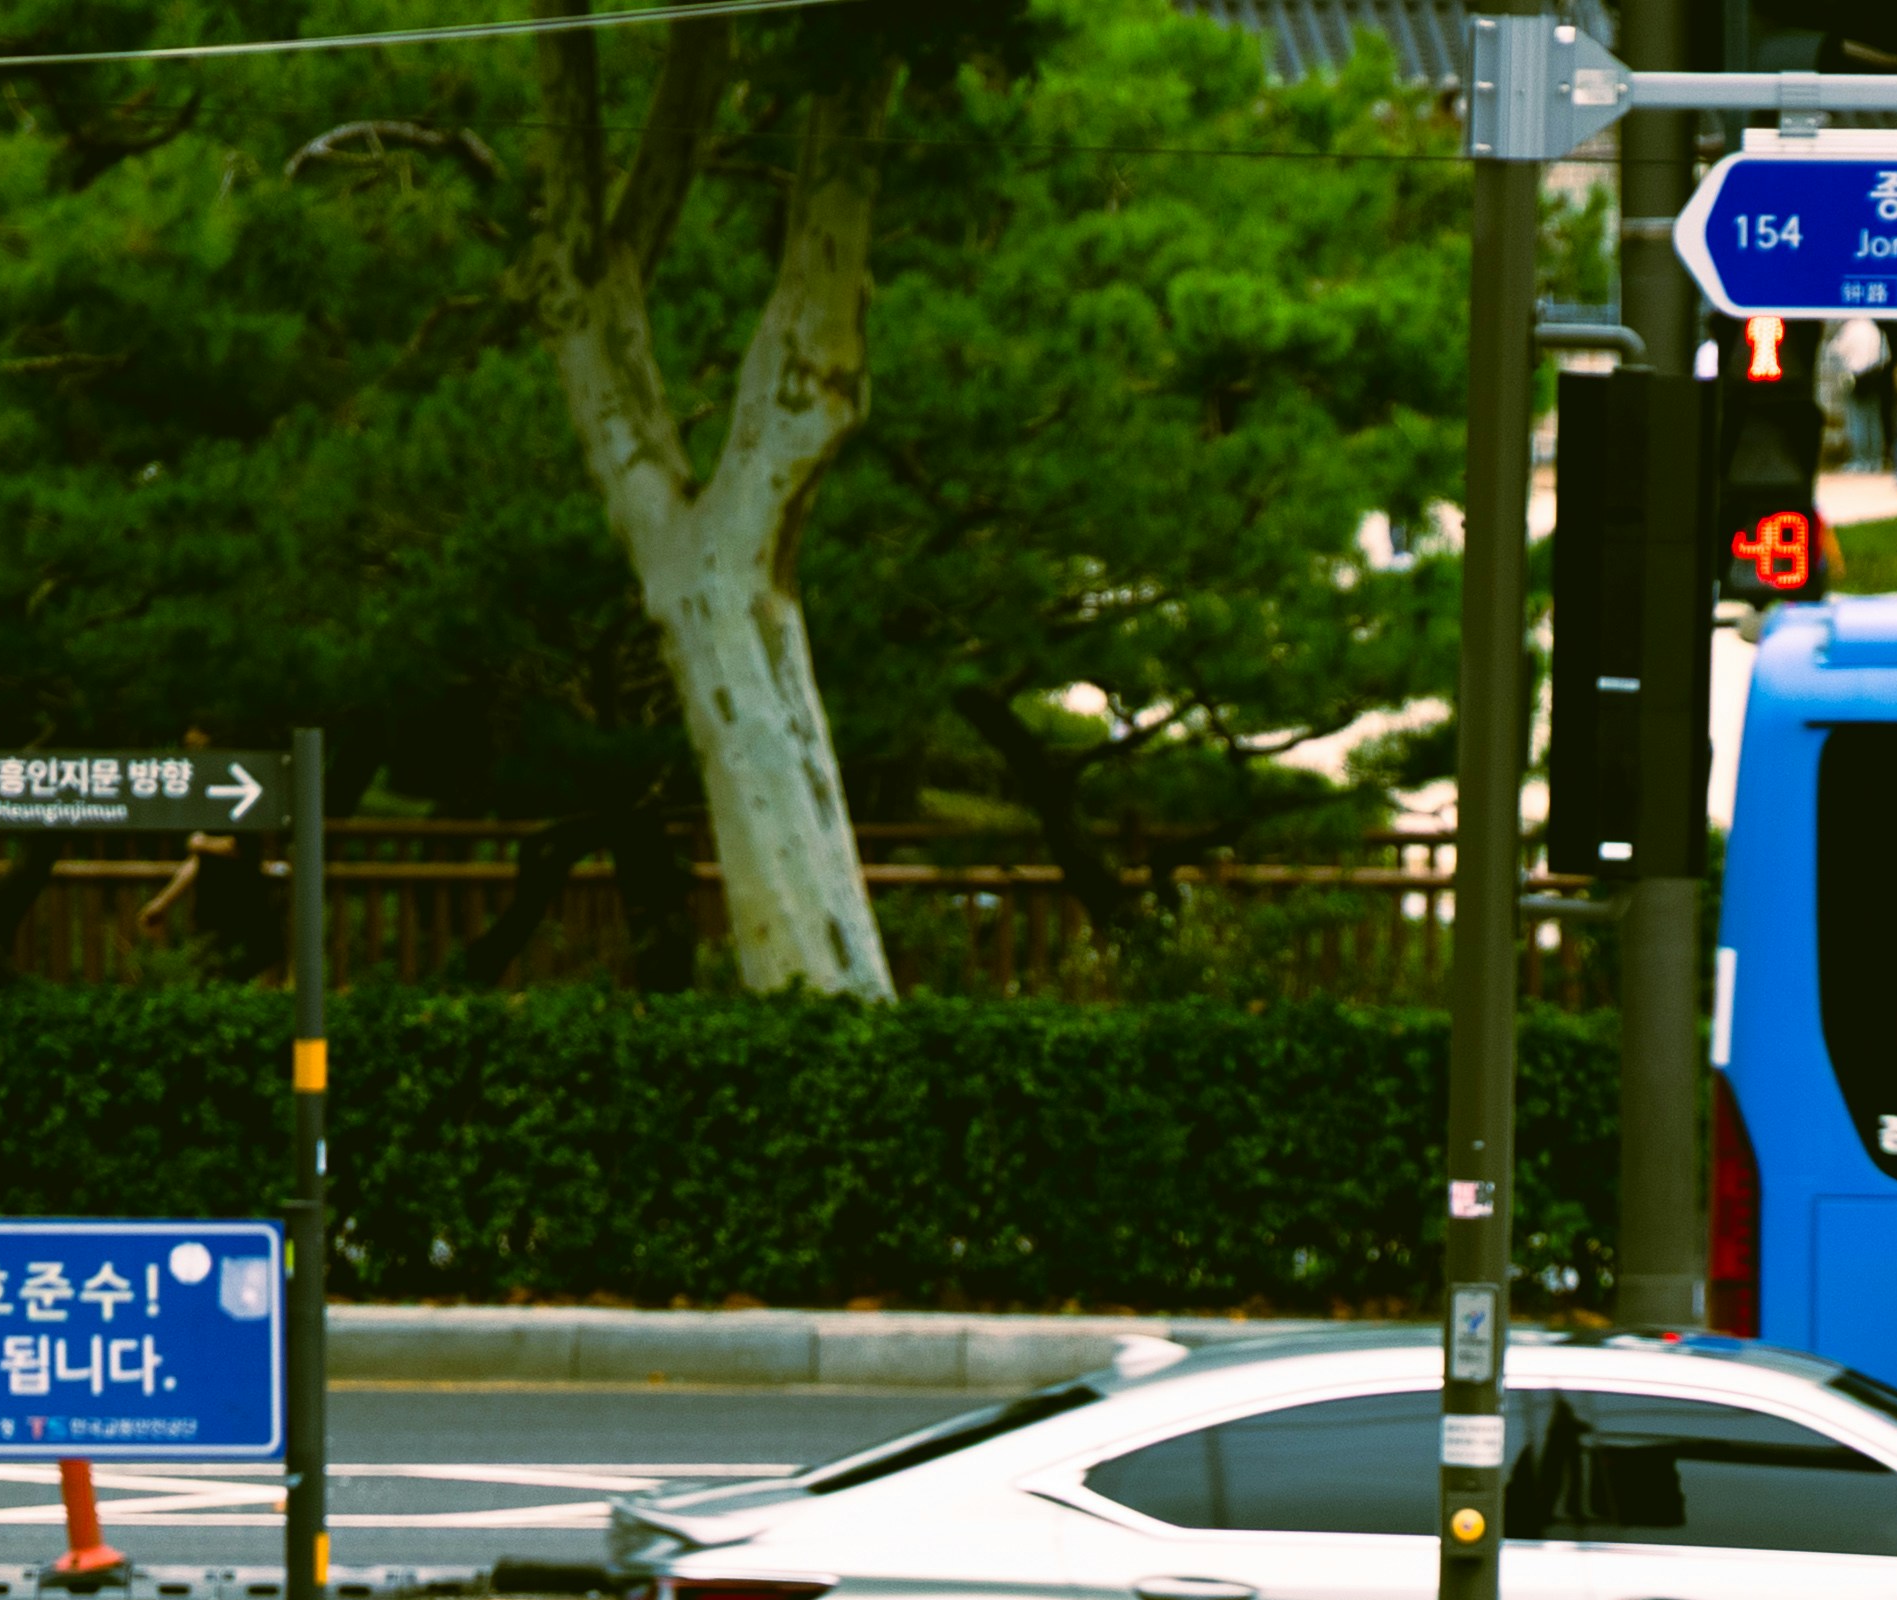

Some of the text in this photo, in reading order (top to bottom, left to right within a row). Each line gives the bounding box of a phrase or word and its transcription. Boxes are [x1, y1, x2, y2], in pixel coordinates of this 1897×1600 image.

[1736, 214, 1804, 251] 154
[128, 759, 194, 798] 방향
[0, 1335, 178, 1396] 됩니다.
